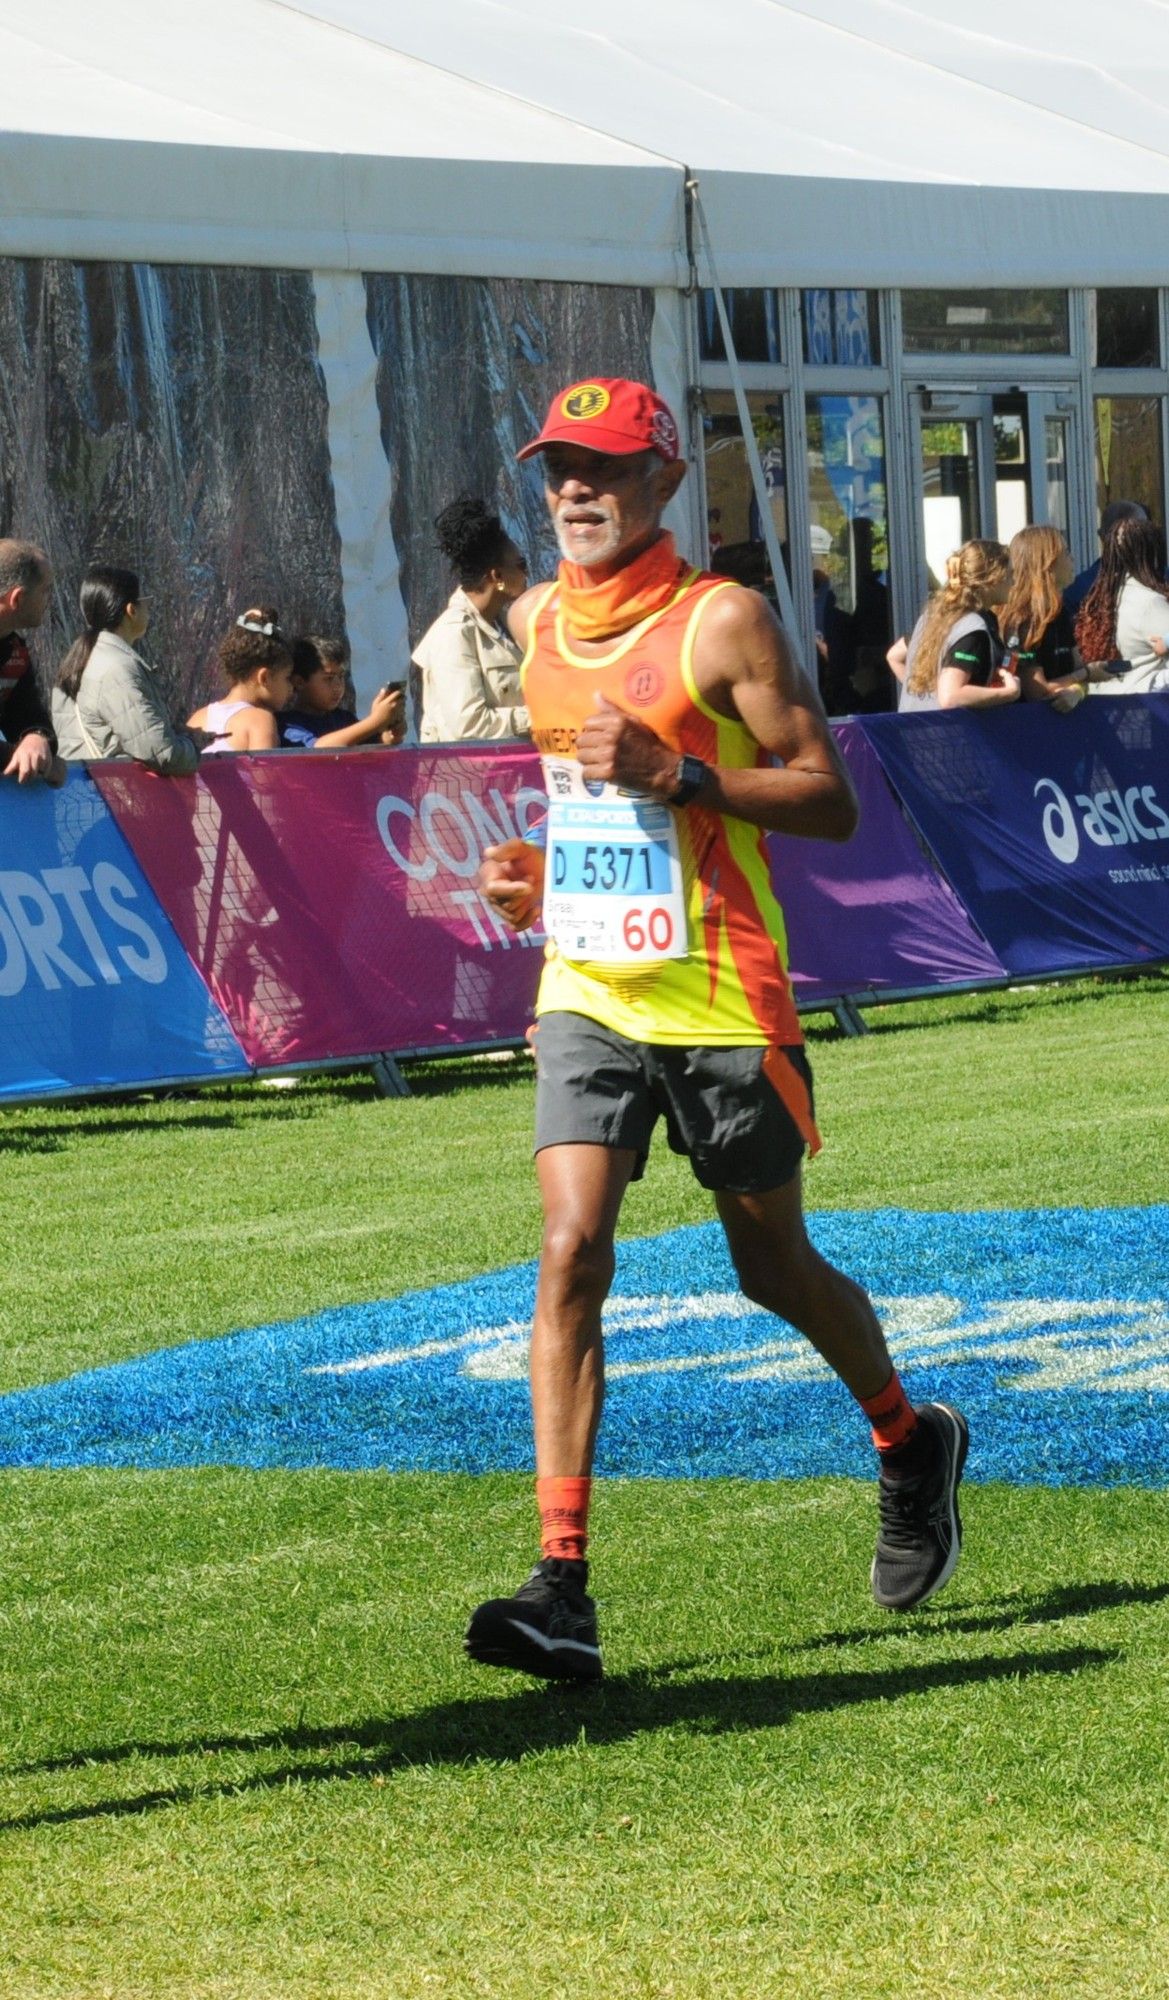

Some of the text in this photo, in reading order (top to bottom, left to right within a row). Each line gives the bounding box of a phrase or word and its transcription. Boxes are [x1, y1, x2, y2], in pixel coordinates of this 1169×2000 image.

[1074, 785, 1169, 846] asics
[582, 846, 653, 889] 5371
[623, 908, 673, 951] 60
